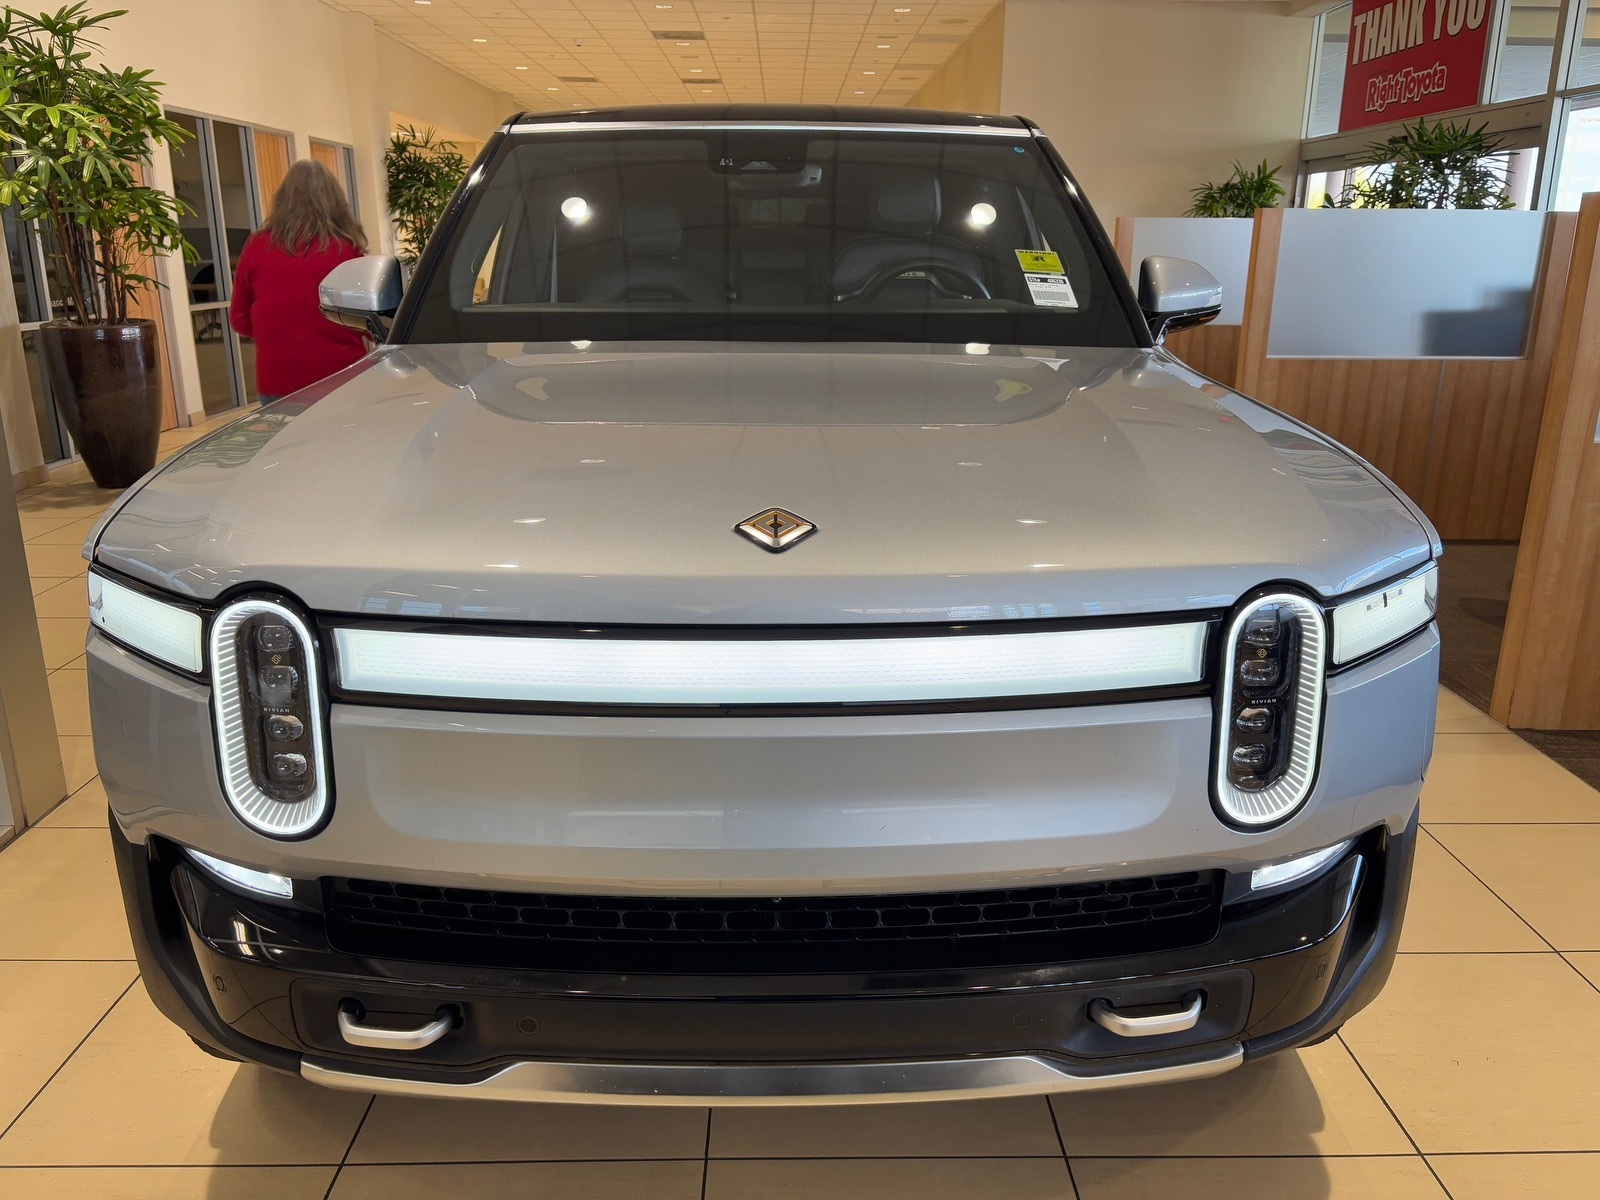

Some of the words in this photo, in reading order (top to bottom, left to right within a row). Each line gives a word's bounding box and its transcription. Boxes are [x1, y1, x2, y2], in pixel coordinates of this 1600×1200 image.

[1352, 0, 1426, 65] THANK
[1365, 72, 1400, 112] Right
[1400, 61, 1447, 104] Toyota
